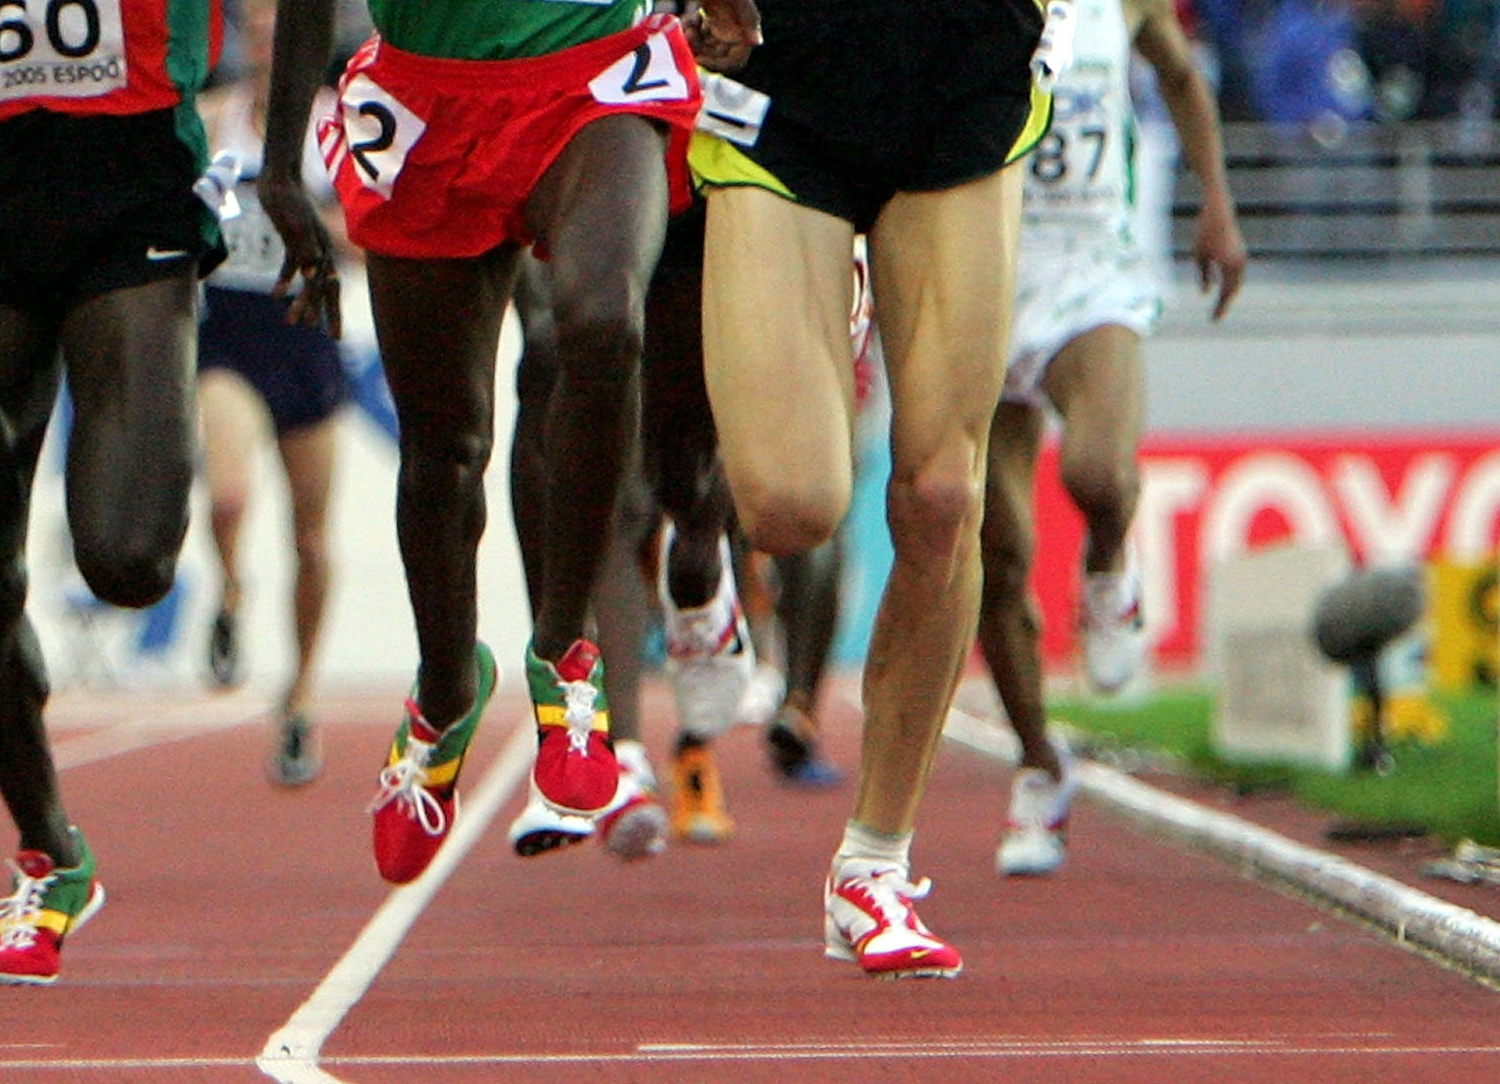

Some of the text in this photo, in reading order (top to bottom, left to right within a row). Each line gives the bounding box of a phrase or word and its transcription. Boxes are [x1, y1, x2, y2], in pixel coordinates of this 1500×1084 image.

[622, 42, 669, 94] 2
[351, 101, 396, 181] 2
[1132, 450, 1500, 651] TOY
